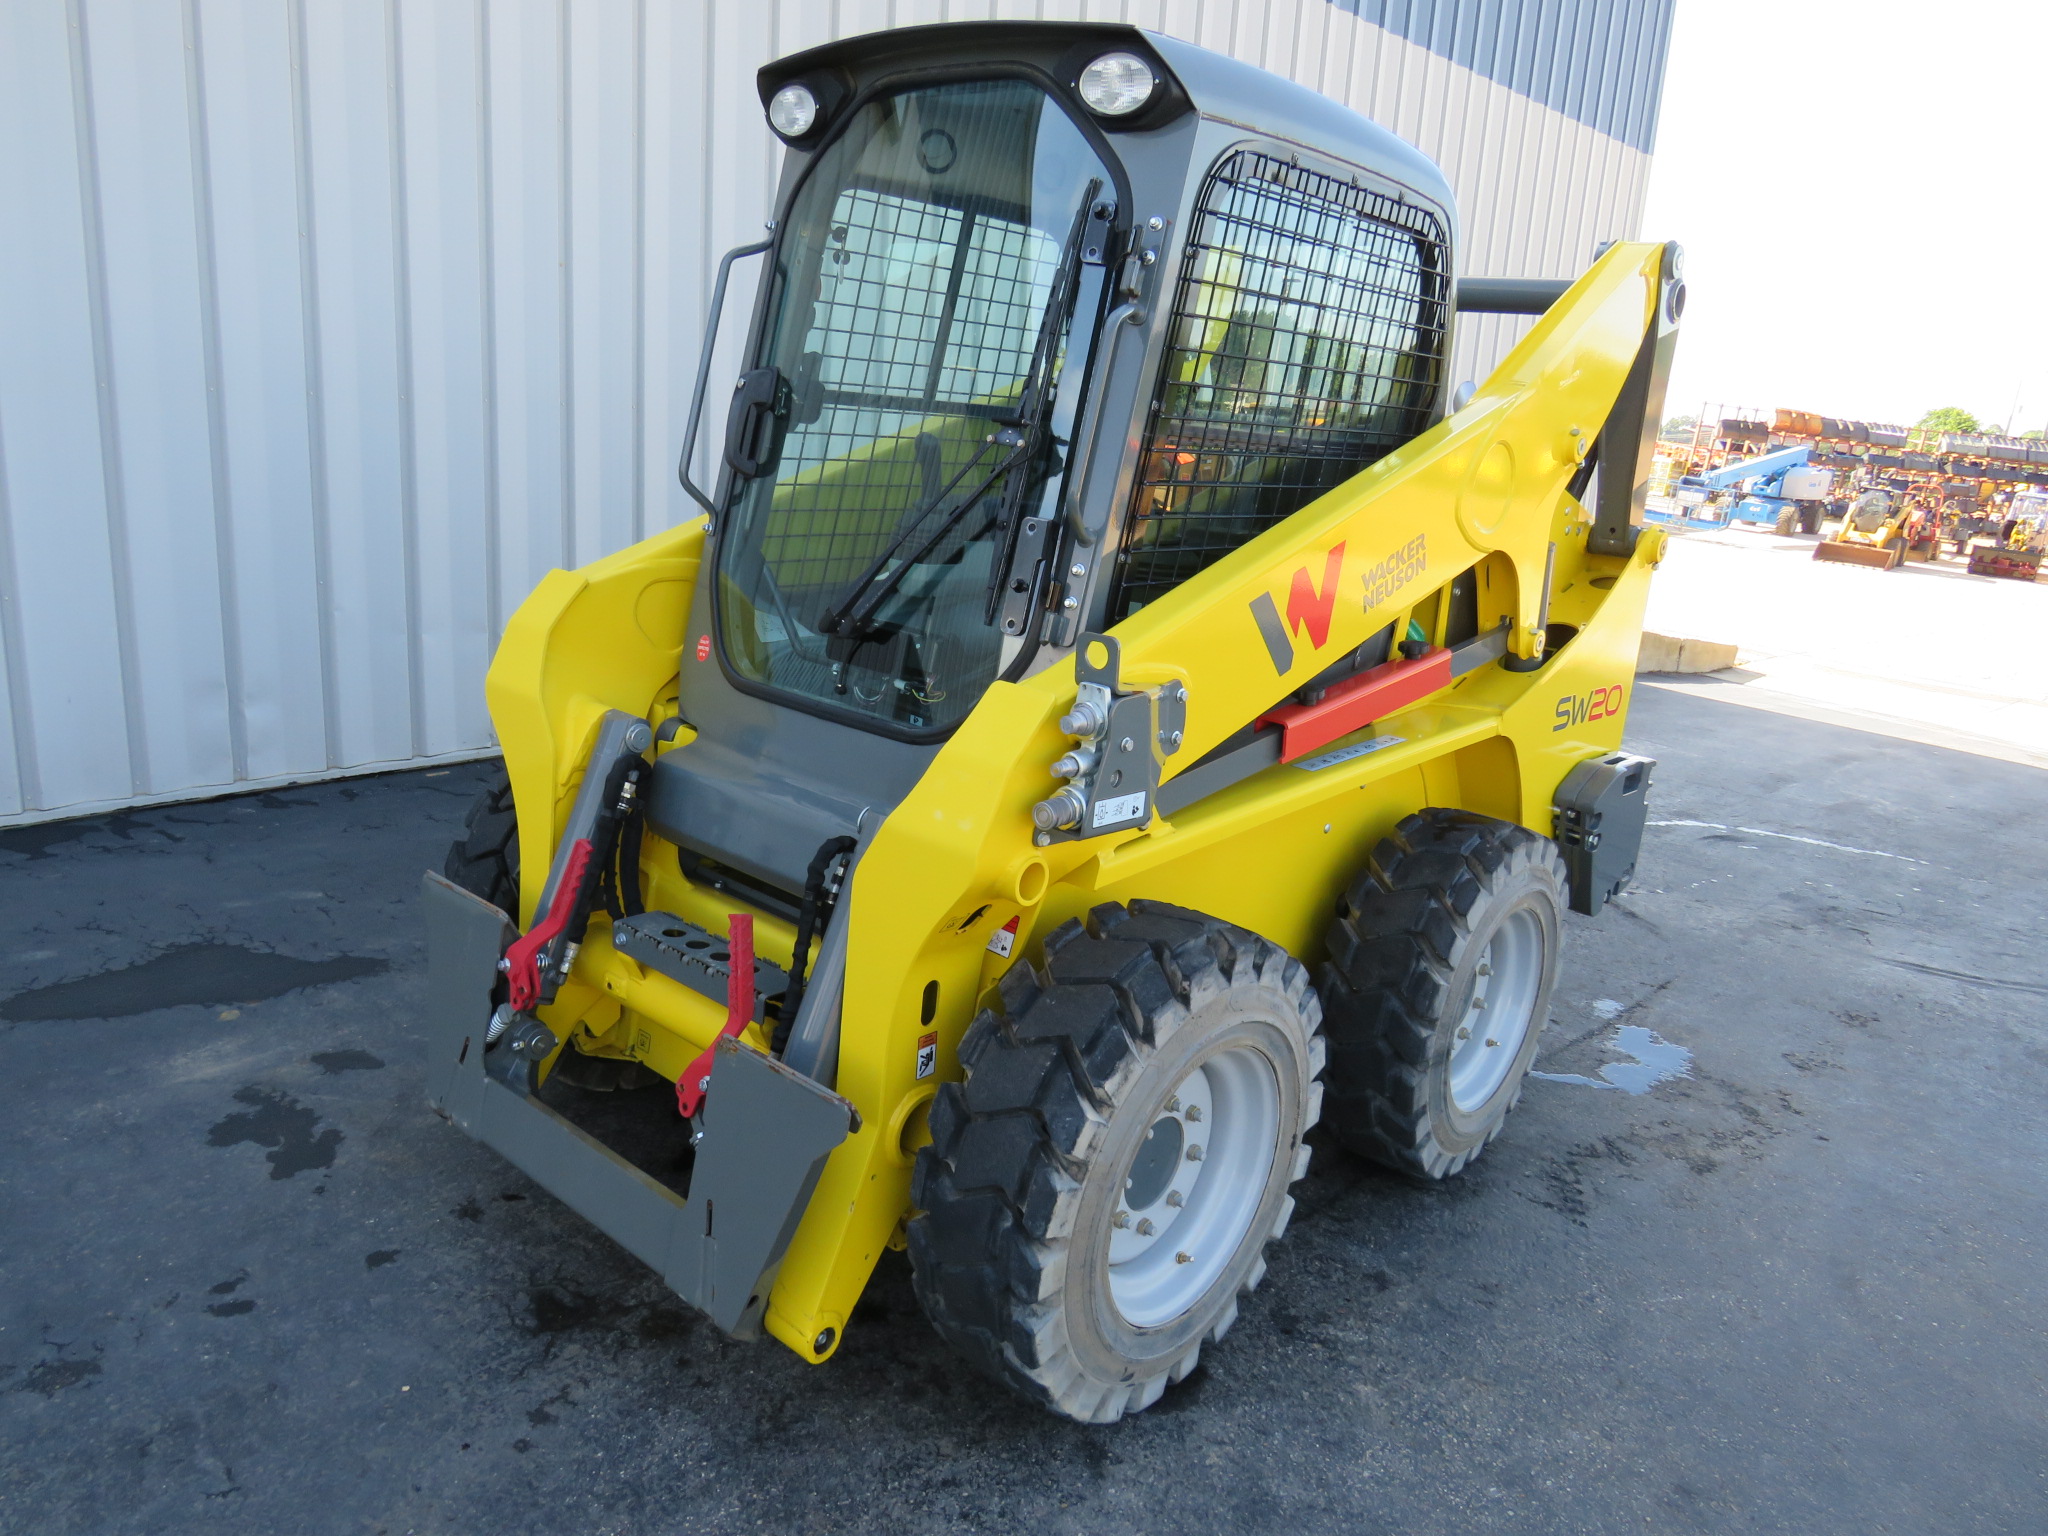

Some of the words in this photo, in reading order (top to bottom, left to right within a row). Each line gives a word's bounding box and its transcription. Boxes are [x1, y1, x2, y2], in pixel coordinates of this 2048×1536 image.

[1361, 533, 1427, 591] WACKER
[1362, 552, 1427, 614] NEUSON
[1552, 684, 1622, 732] SW20
